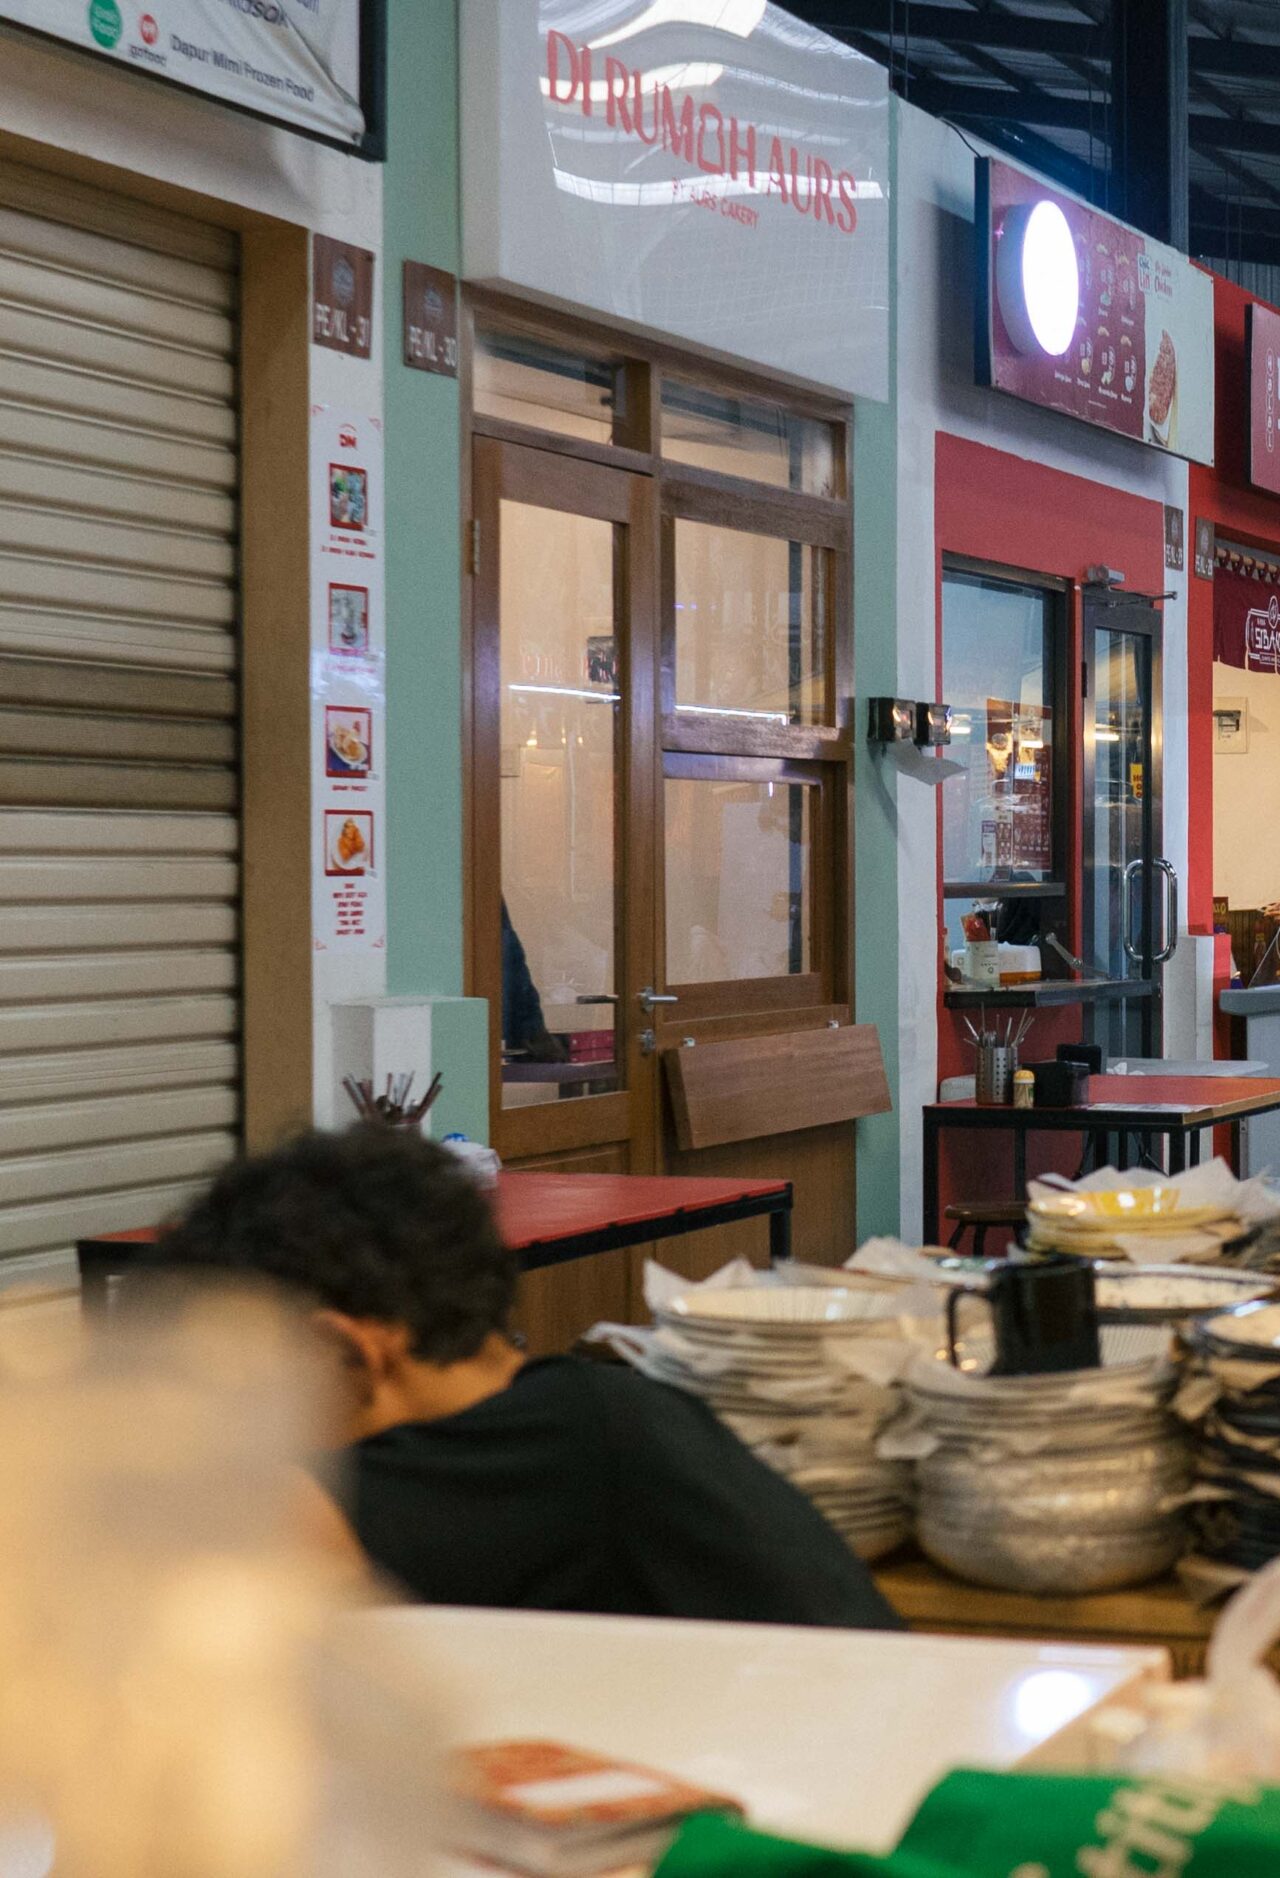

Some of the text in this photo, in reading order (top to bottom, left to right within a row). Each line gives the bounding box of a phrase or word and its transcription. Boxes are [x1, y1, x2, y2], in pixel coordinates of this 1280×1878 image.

[171, 34, 315, 103] Dapur Mimi Frozen Food
[547, 29, 593, 117] DI
[767, 136, 858, 234] AURS
